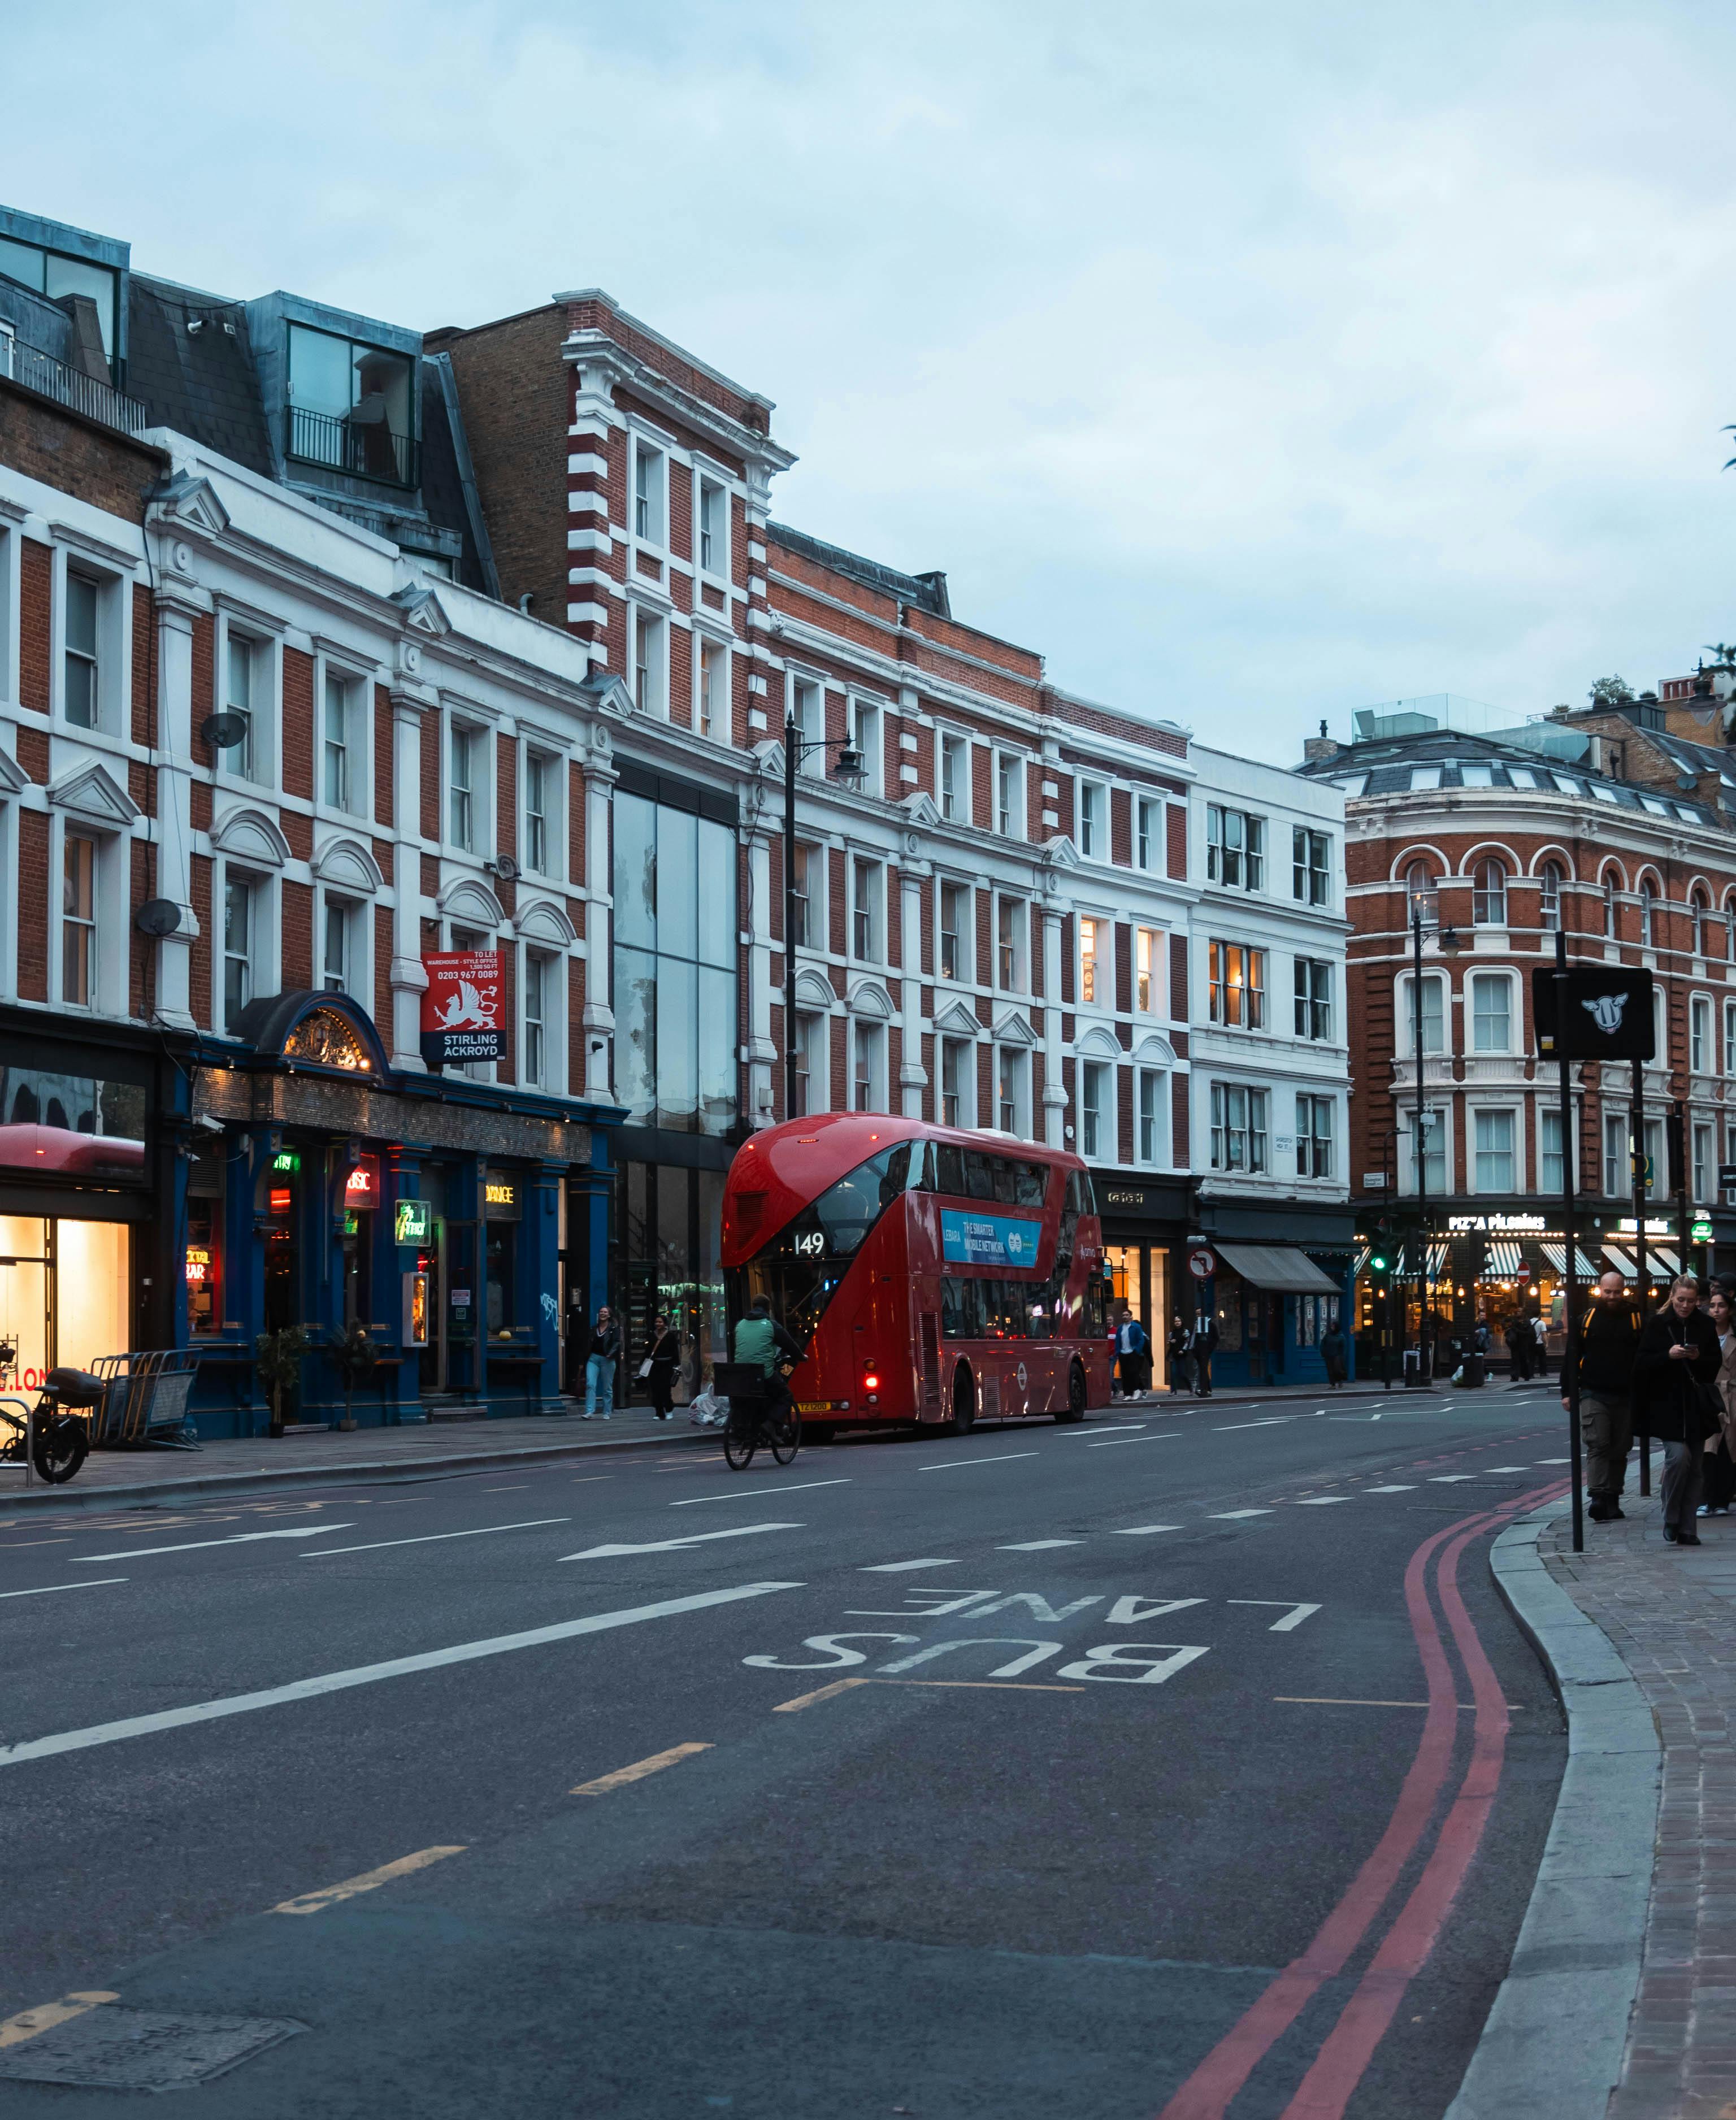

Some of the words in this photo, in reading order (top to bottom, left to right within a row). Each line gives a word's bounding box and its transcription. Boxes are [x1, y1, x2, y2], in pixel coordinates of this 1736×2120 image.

[444, 1035, 497, 1045] STIRLING
[444, 1046, 498, 1056] ACKROYD
[347, 1172, 370, 1190] USIC
[485, 1185, 514, 1204] DANCE
[795, 1232, 824, 1255] 149
[964, 1238, 982, 1251] MOBILE
[981, 1240, 1005, 1254] NETWORK
[186, 1263, 205, 1280] BAR
[843, 1588, 1322, 1632] LANE
[741, 1632, 1211, 1684] BUS
